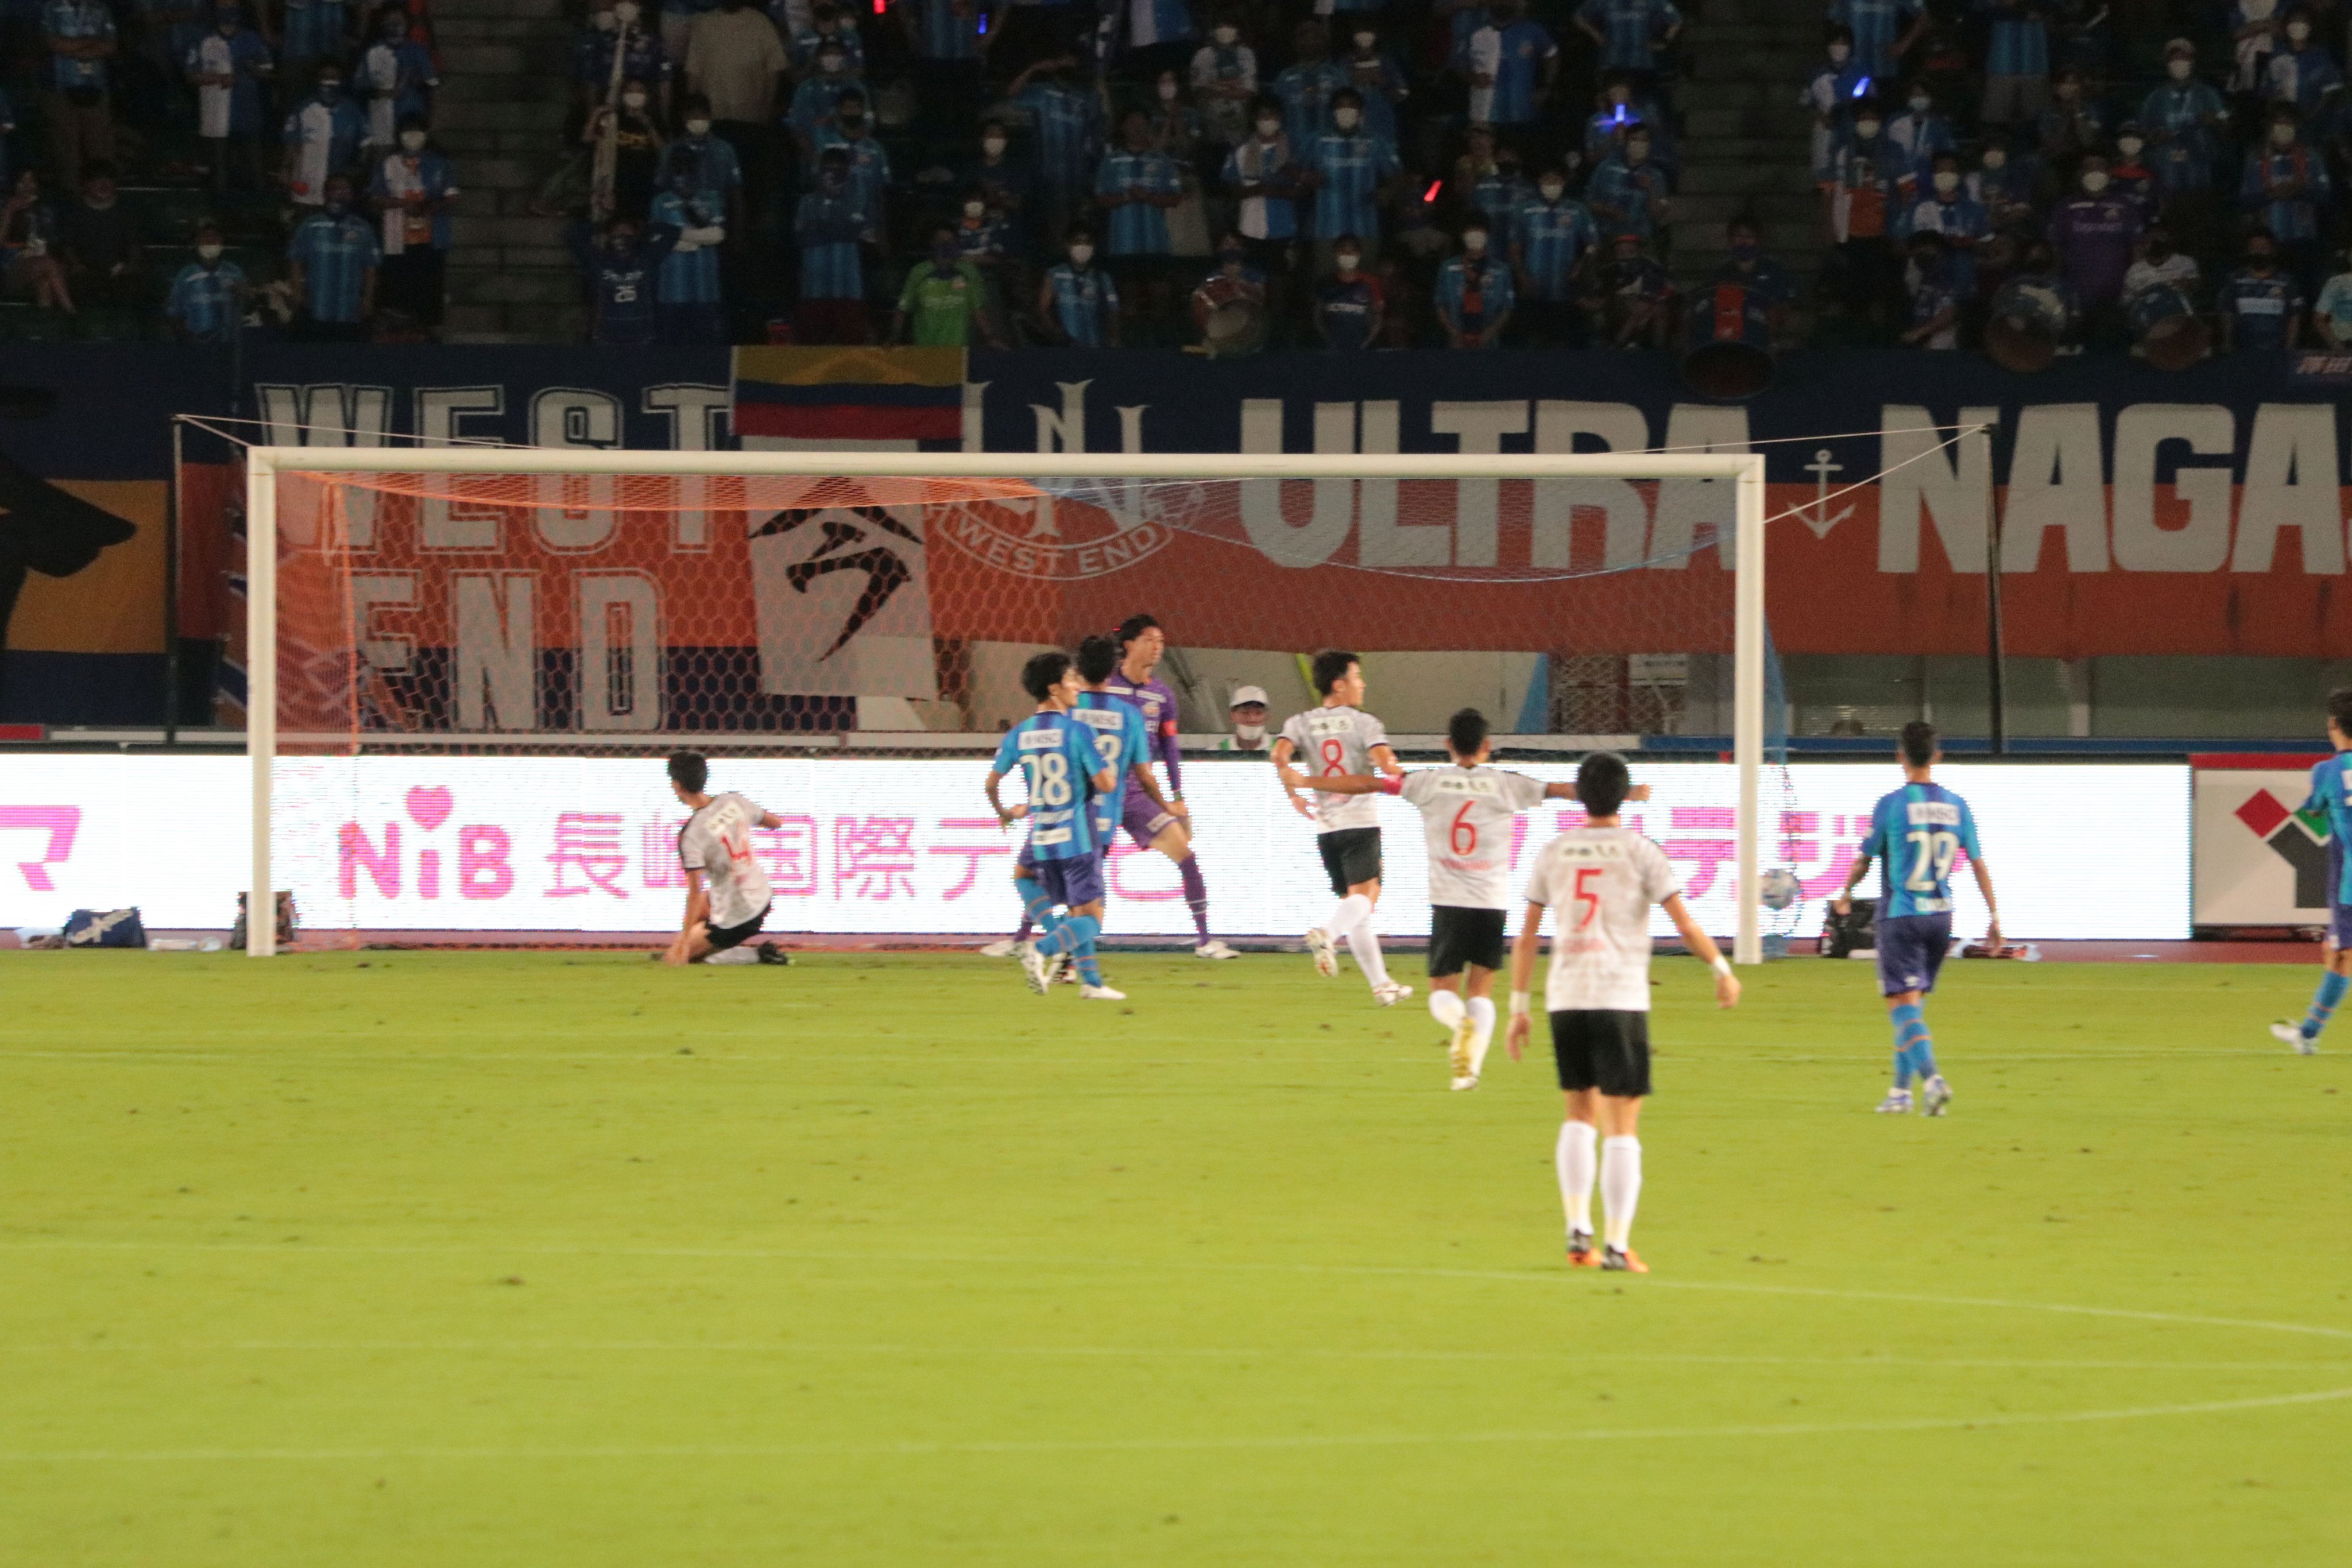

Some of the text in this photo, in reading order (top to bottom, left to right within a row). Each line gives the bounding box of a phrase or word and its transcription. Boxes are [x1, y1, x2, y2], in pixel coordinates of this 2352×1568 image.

[1240, 398, 2352, 574] ULTRA NAGA
[953, 516, 1158, 575] WEST END
[334, 567, 666, 731] END
[1019, 753, 1072, 806] 28
[1321, 738, 1347, 777] 8
[1449, 799, 1477, 857] 6
[1905, 831, 1959, 891] 29
[1572, 868, 1604, 933] 5
